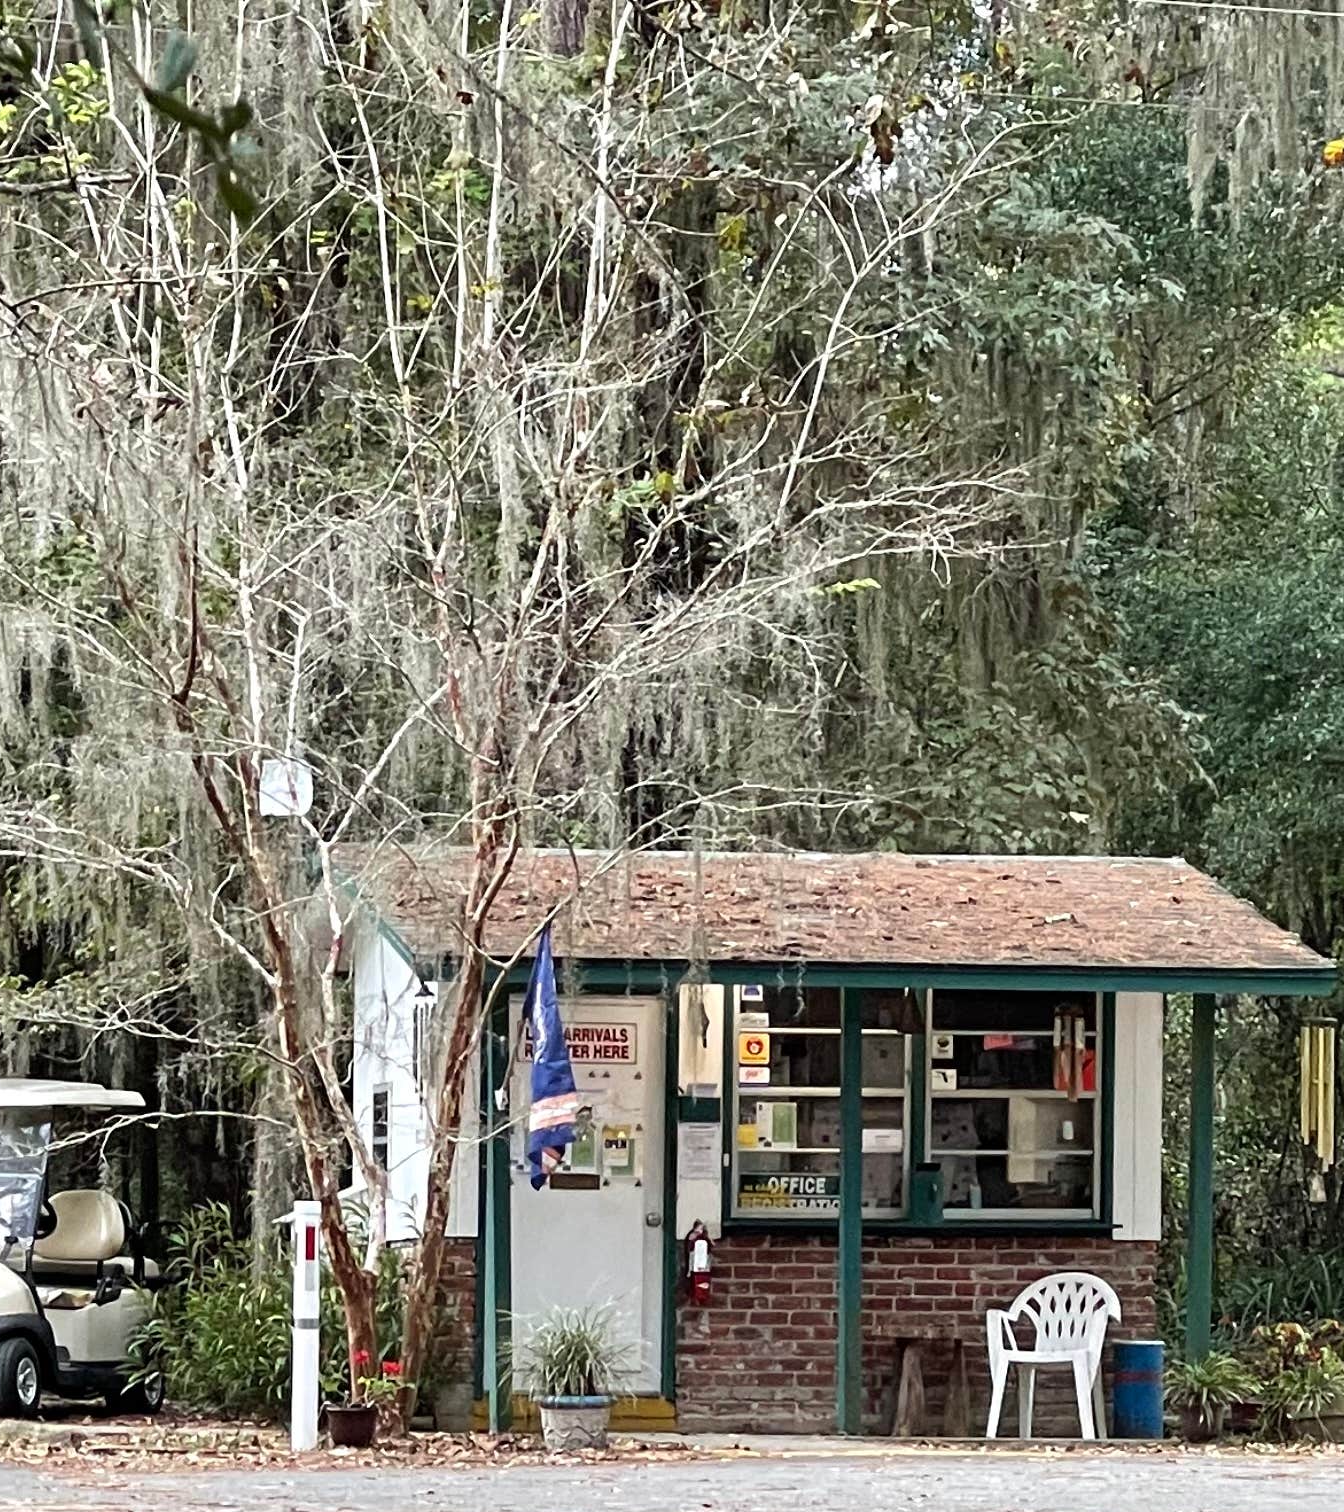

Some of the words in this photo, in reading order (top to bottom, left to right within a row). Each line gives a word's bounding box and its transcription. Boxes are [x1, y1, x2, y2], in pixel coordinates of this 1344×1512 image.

[564, 1027, 628, 1043] ARRIVALS
[593, 1044, 629, 1059] HERE
[767, 1176, 826, 1194] OFFICE
